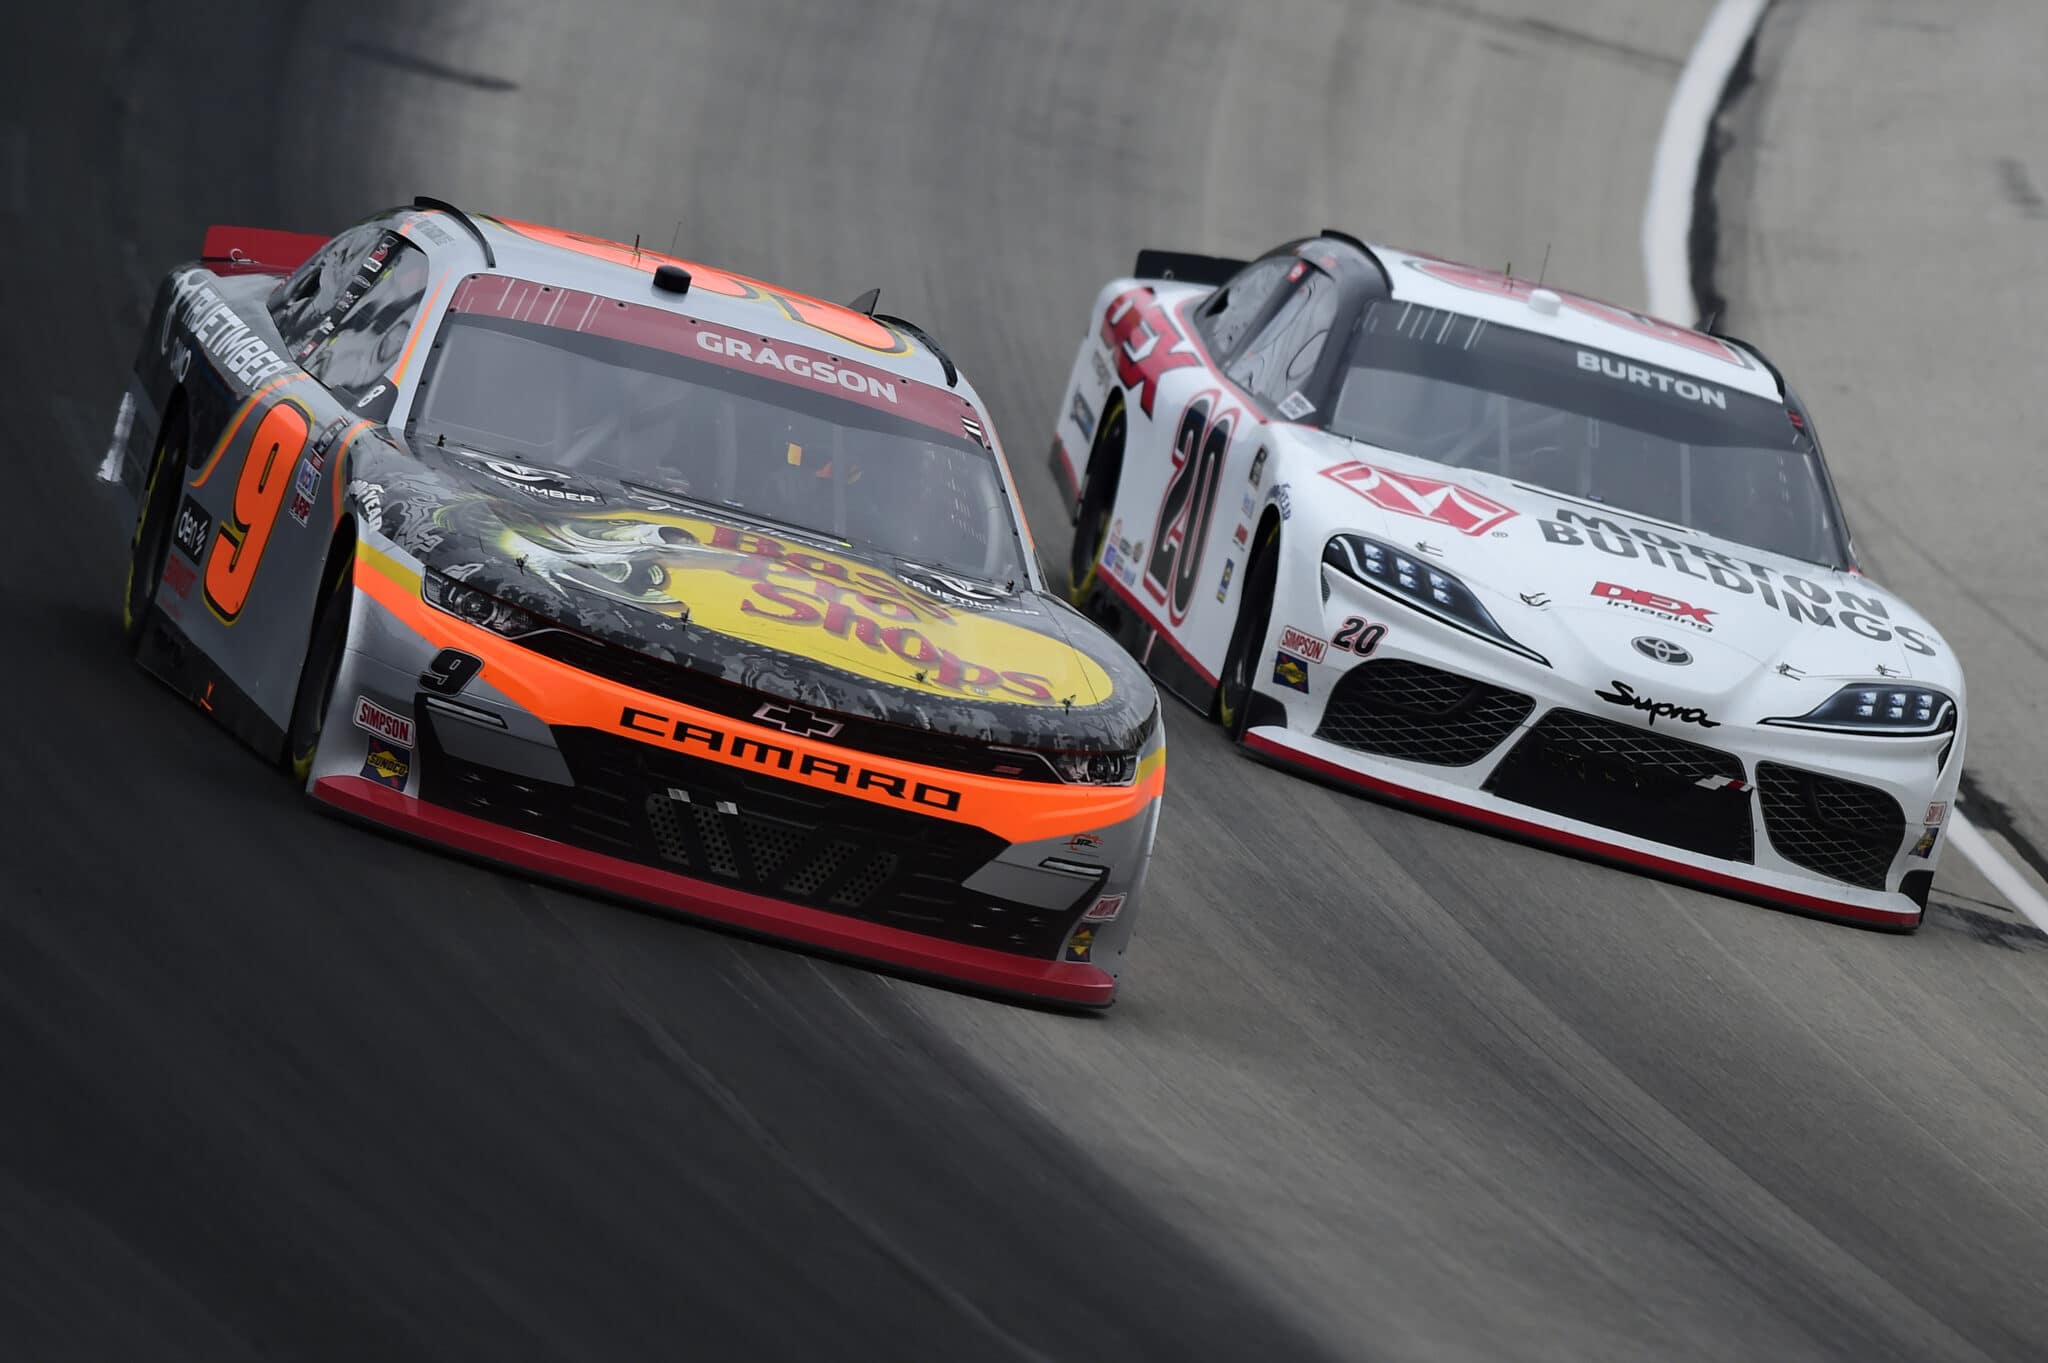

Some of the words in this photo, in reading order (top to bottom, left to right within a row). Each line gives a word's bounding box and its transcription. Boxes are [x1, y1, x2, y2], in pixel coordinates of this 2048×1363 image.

[696, 331, 898, 404] GRAGSON
[1576, 350, 1727, 410] BURTON
[202, 394, 315, 625] 9
[1143, 389, 1241, 628] 20
[704, 525, 956, 625] Bass
[727, 557, 922, 623] Pro
[1536, 518, 1937, 657] BUILDINGS
[1555, 508, 1891, 621] MORTON
[1590, 581, 1720, 627] DEX
[1606, 600, 1714, 633] imaging
[740, 582, 1057, 706] Shops
[1281, 629, 1325, 660] SIMPSON
[1330, 616, 1389, 658] 20
[418, 647, 485, 698] 9
[359, 703, 411, 741] SIMPSON
[1594, 680, 1722, 729] Supra
[368, 753, 408, 777] SUNOCO
[619, 706, 962, 812] CAMARO
